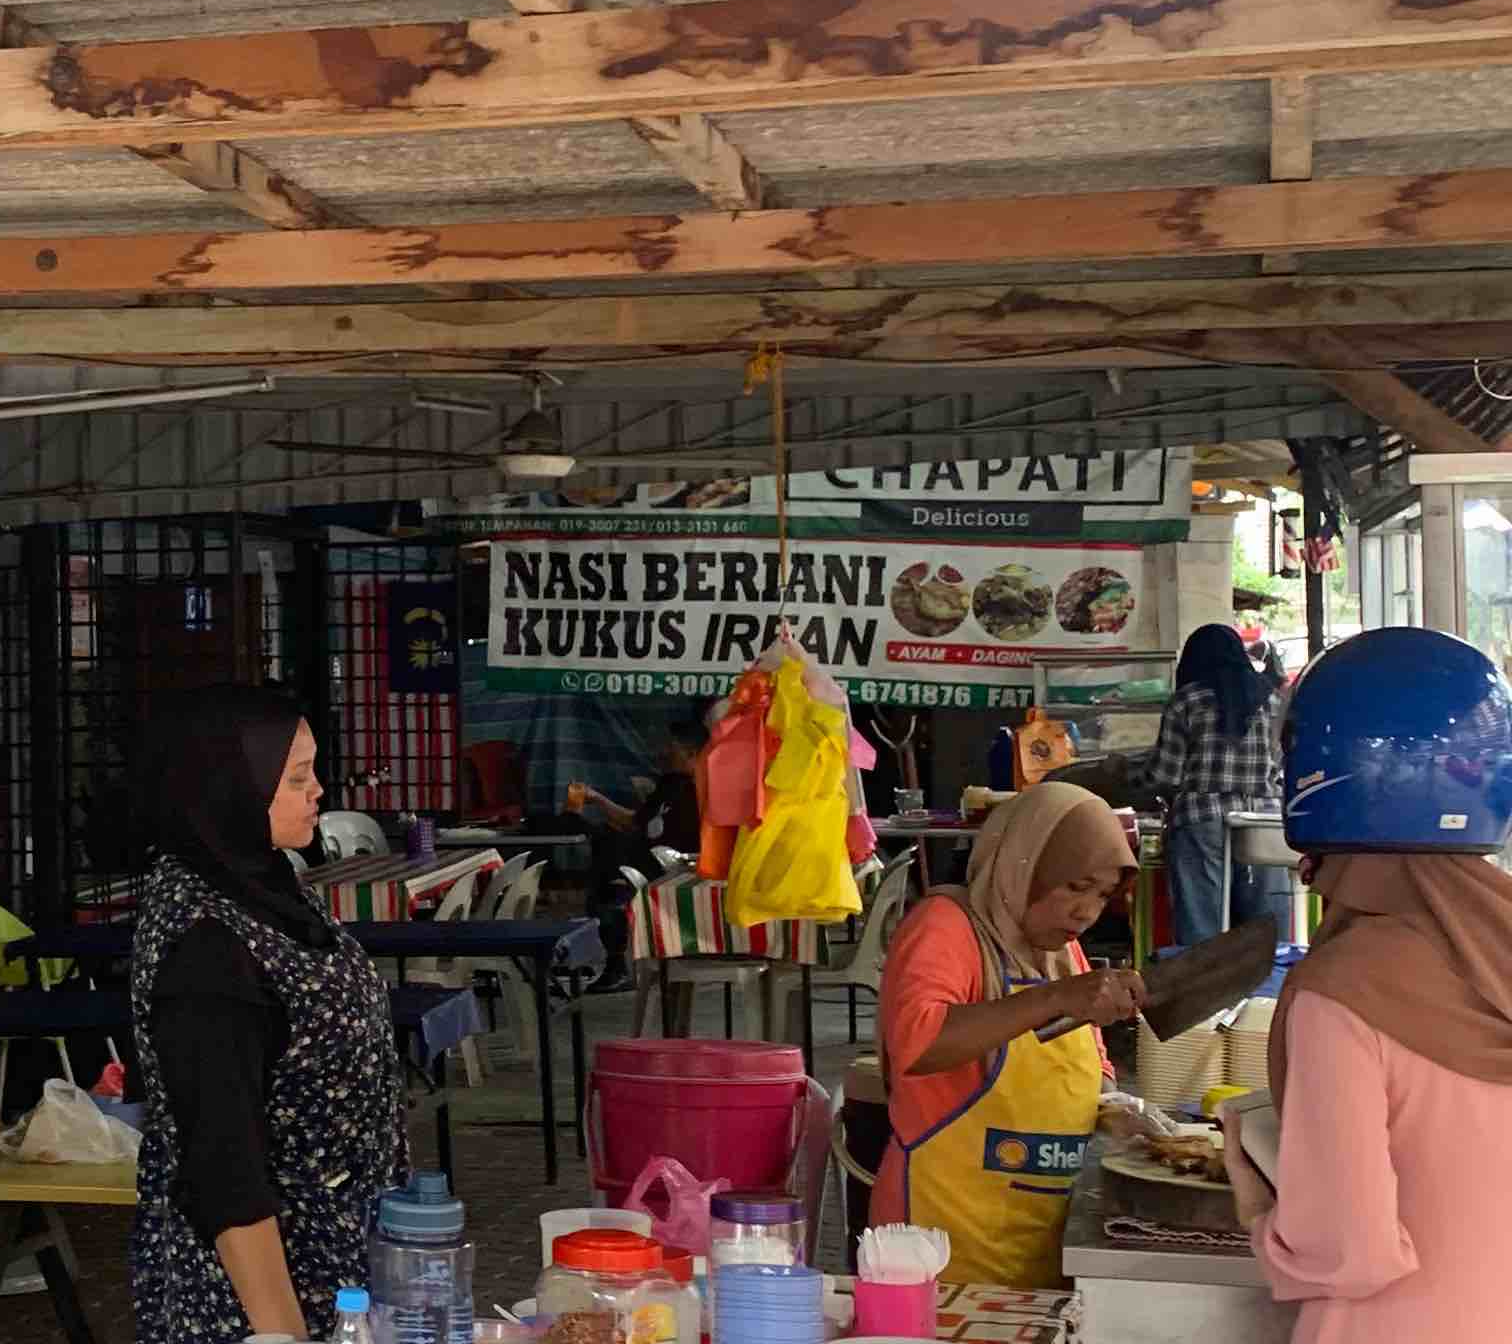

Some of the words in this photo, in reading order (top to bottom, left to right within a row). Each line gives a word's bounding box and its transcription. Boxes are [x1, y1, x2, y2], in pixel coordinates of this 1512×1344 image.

[912, 508, 1029, 528] Delicious
[504, 552, 628, 601] NASI
[642, 552, 887, 607] BERIANI
[502, 606, 686, 660] KUKUS
[897, 646, 947, 661] AYAM
[1037, 1142, 1090, 1169] Shel
